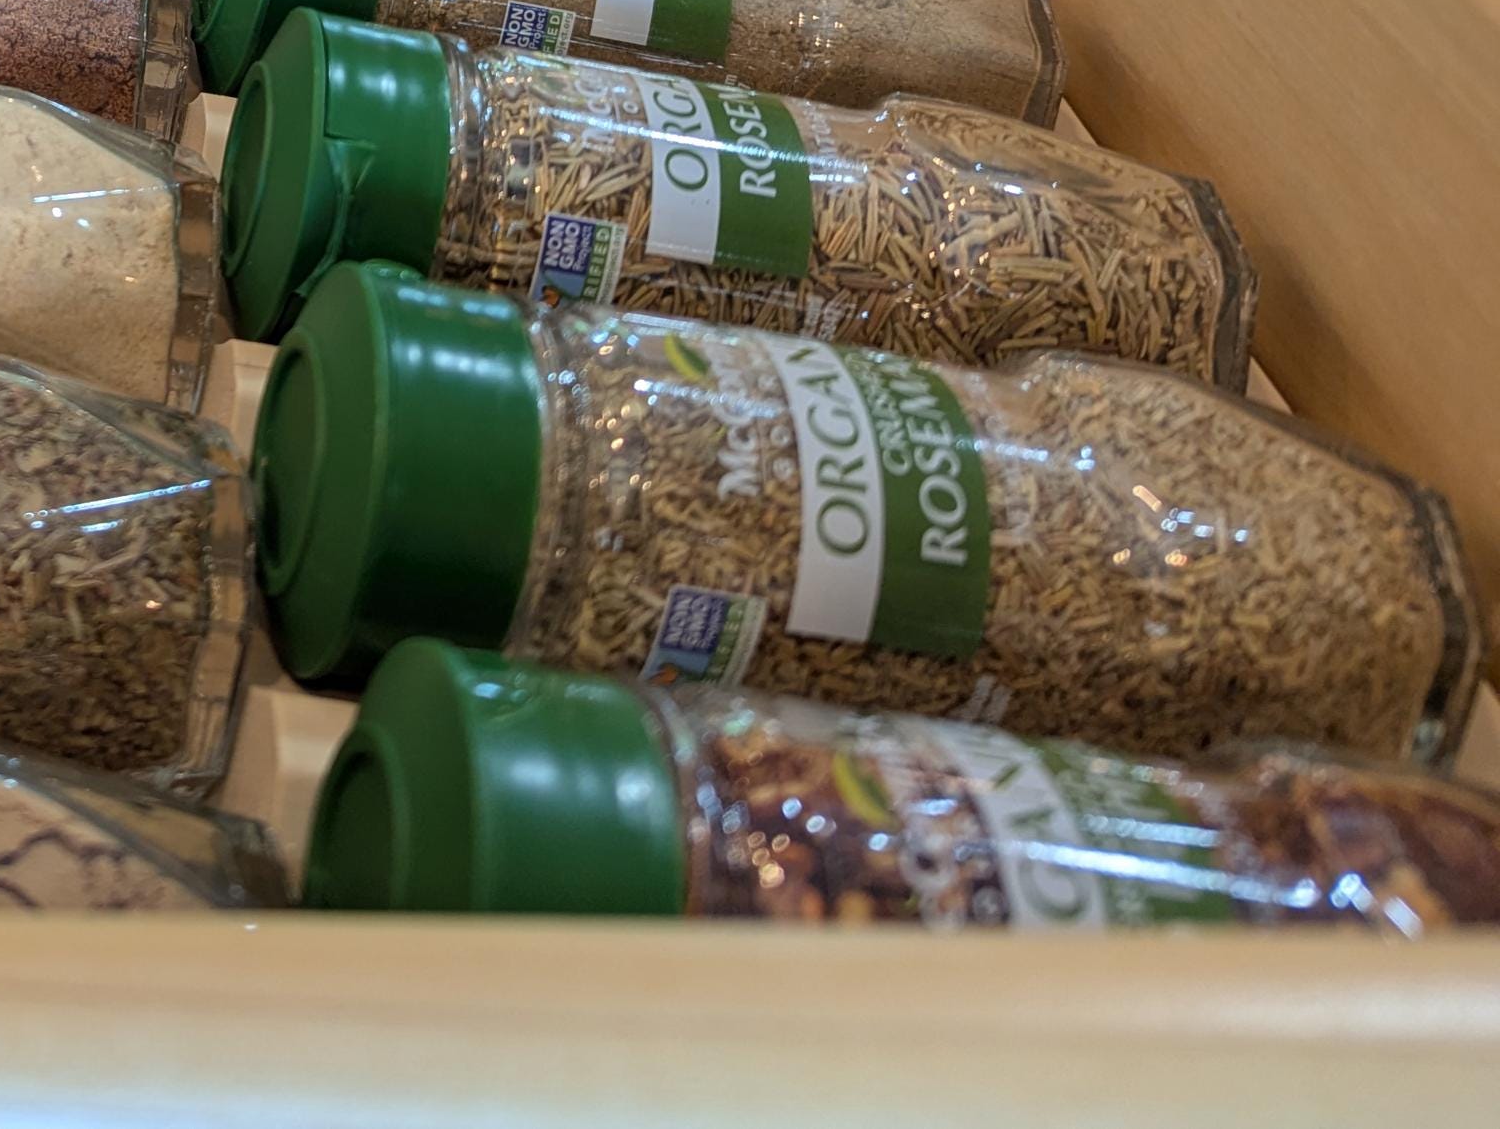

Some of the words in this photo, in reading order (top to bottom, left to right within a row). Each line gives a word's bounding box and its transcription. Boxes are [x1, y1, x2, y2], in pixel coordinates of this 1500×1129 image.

[505, 5, 524, 47] NON
[518, 9, 536, 48] GMO
[544, 220, 567, 265] NON
[559, 222, 582, 269] GMO
